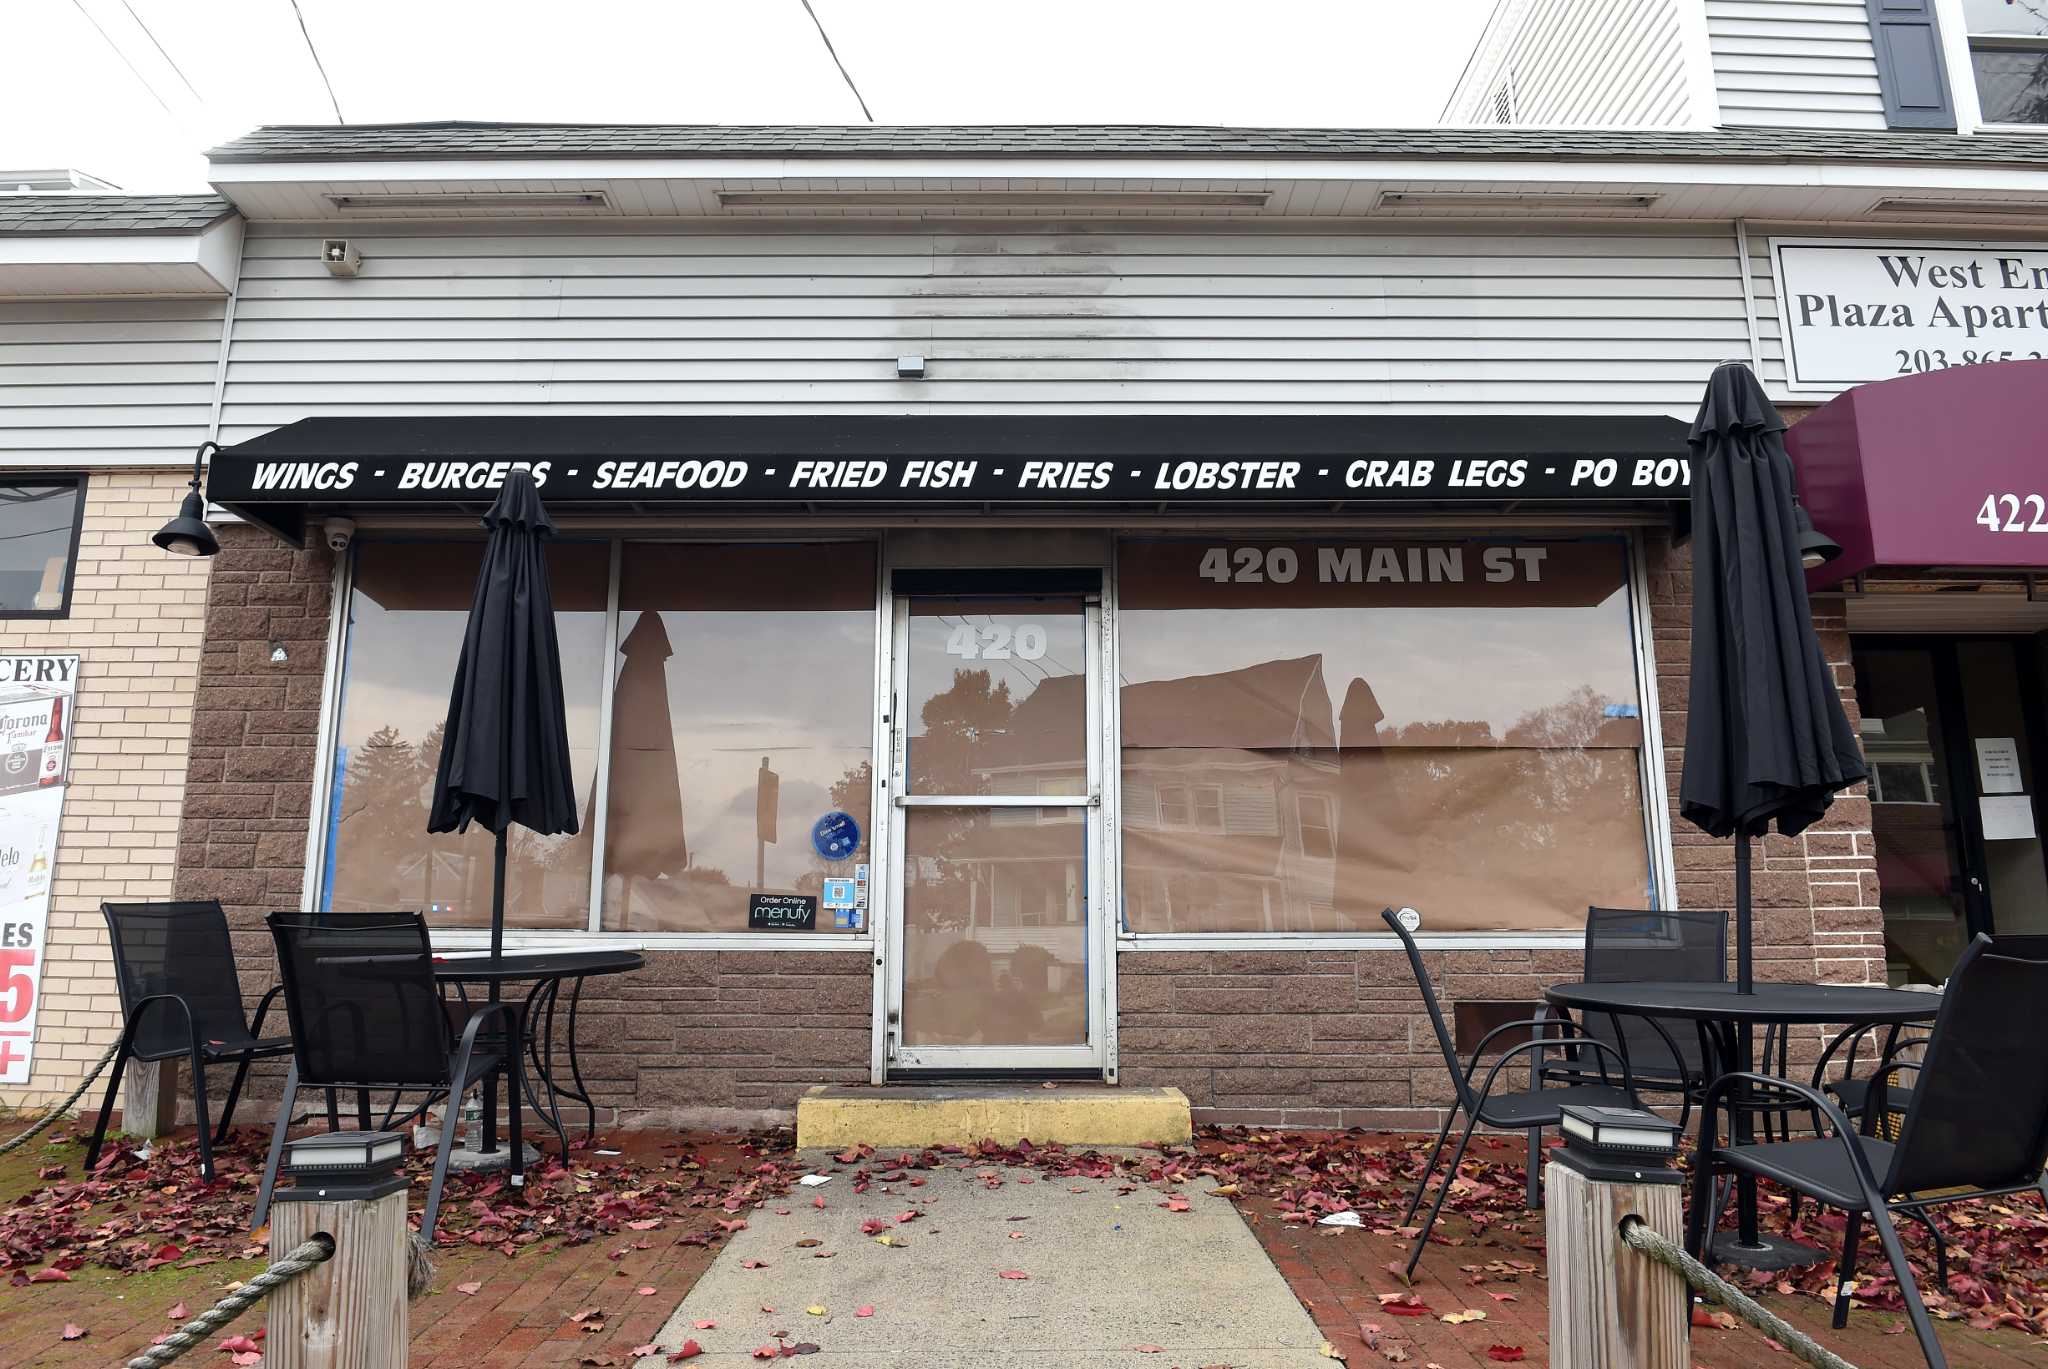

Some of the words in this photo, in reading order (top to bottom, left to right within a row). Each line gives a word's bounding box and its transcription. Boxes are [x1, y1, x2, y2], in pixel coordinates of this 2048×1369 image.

[1877, 256, 1985, 289] West
[1797, 294, 1914, 328] Plaza
[1928, 296, 2048, 338] Apart
[251, 462, 358, 489] WINGS
[592, 460, 748, 489] SEAFOOD
[789, 461, 888, 488] FRIED
[899, 461, 978, 488] FISH
[1017, 461, 1114, 490] FRIES
[1154, 461, 1301, 490] LOBSTER
[1345, 460, 1435, 488] CRAB
[1448, 460, 1528, 488] LEGS
[1570, 458, 1618, 488] PO
[1976, 494, 2048, 533] 422
[1199, 547, 1299, 584] 420
[1317, 547, 1465, 583] MAIN
[1482, 547, 1548, 583] ST
[946, 623, 1047, 660] 420
[0, 846, 20, 868] elo
[754, 905, 811, 923] menufy
[760, 896, 782, 904] Order
[783, 897, 807, 905] Online
